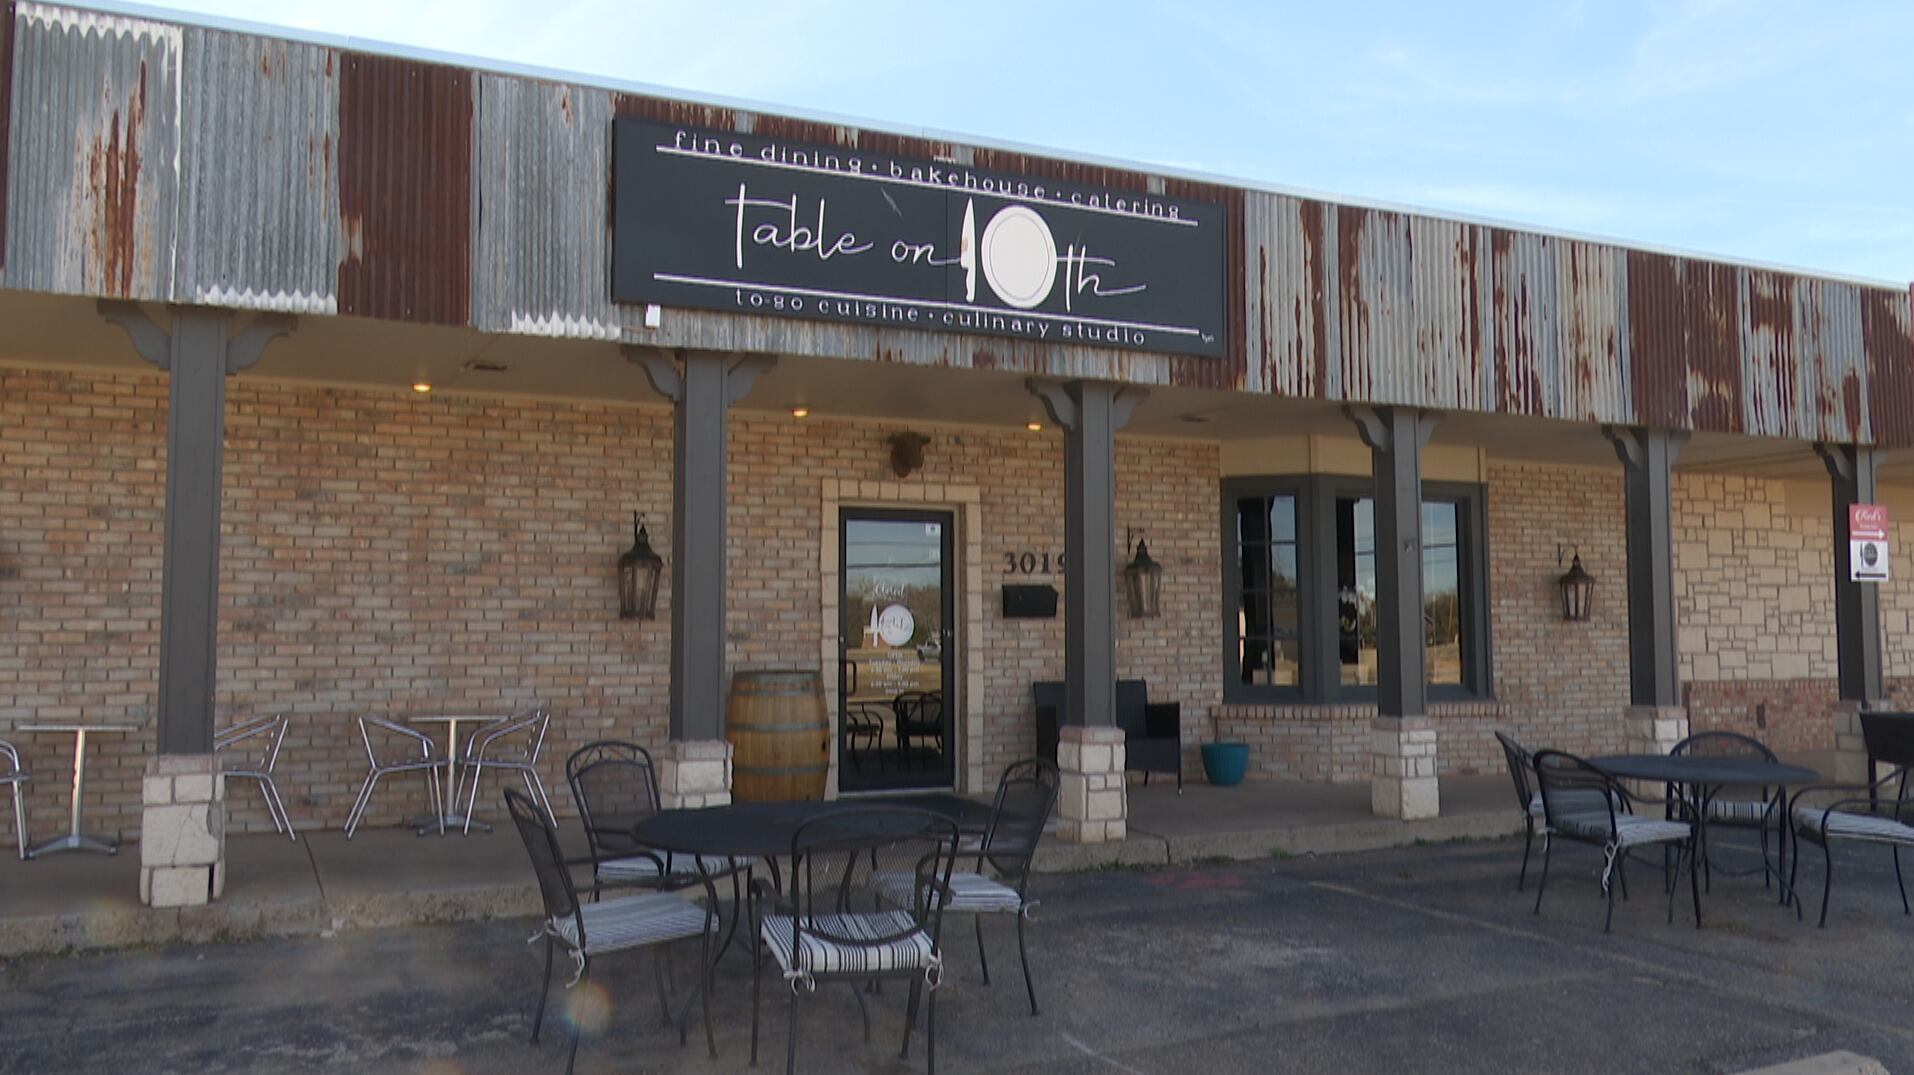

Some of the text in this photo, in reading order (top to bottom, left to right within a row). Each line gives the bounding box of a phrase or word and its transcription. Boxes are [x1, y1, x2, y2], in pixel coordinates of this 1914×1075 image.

[674, 129, 1179, 220] fine dining bakehouse catering
[891, 240, 960, 267] on
[818, 299, 918, 322] cuisine
[943, 312, 1049, 338] culinary
[1062, 322, 1145, 345] studio
